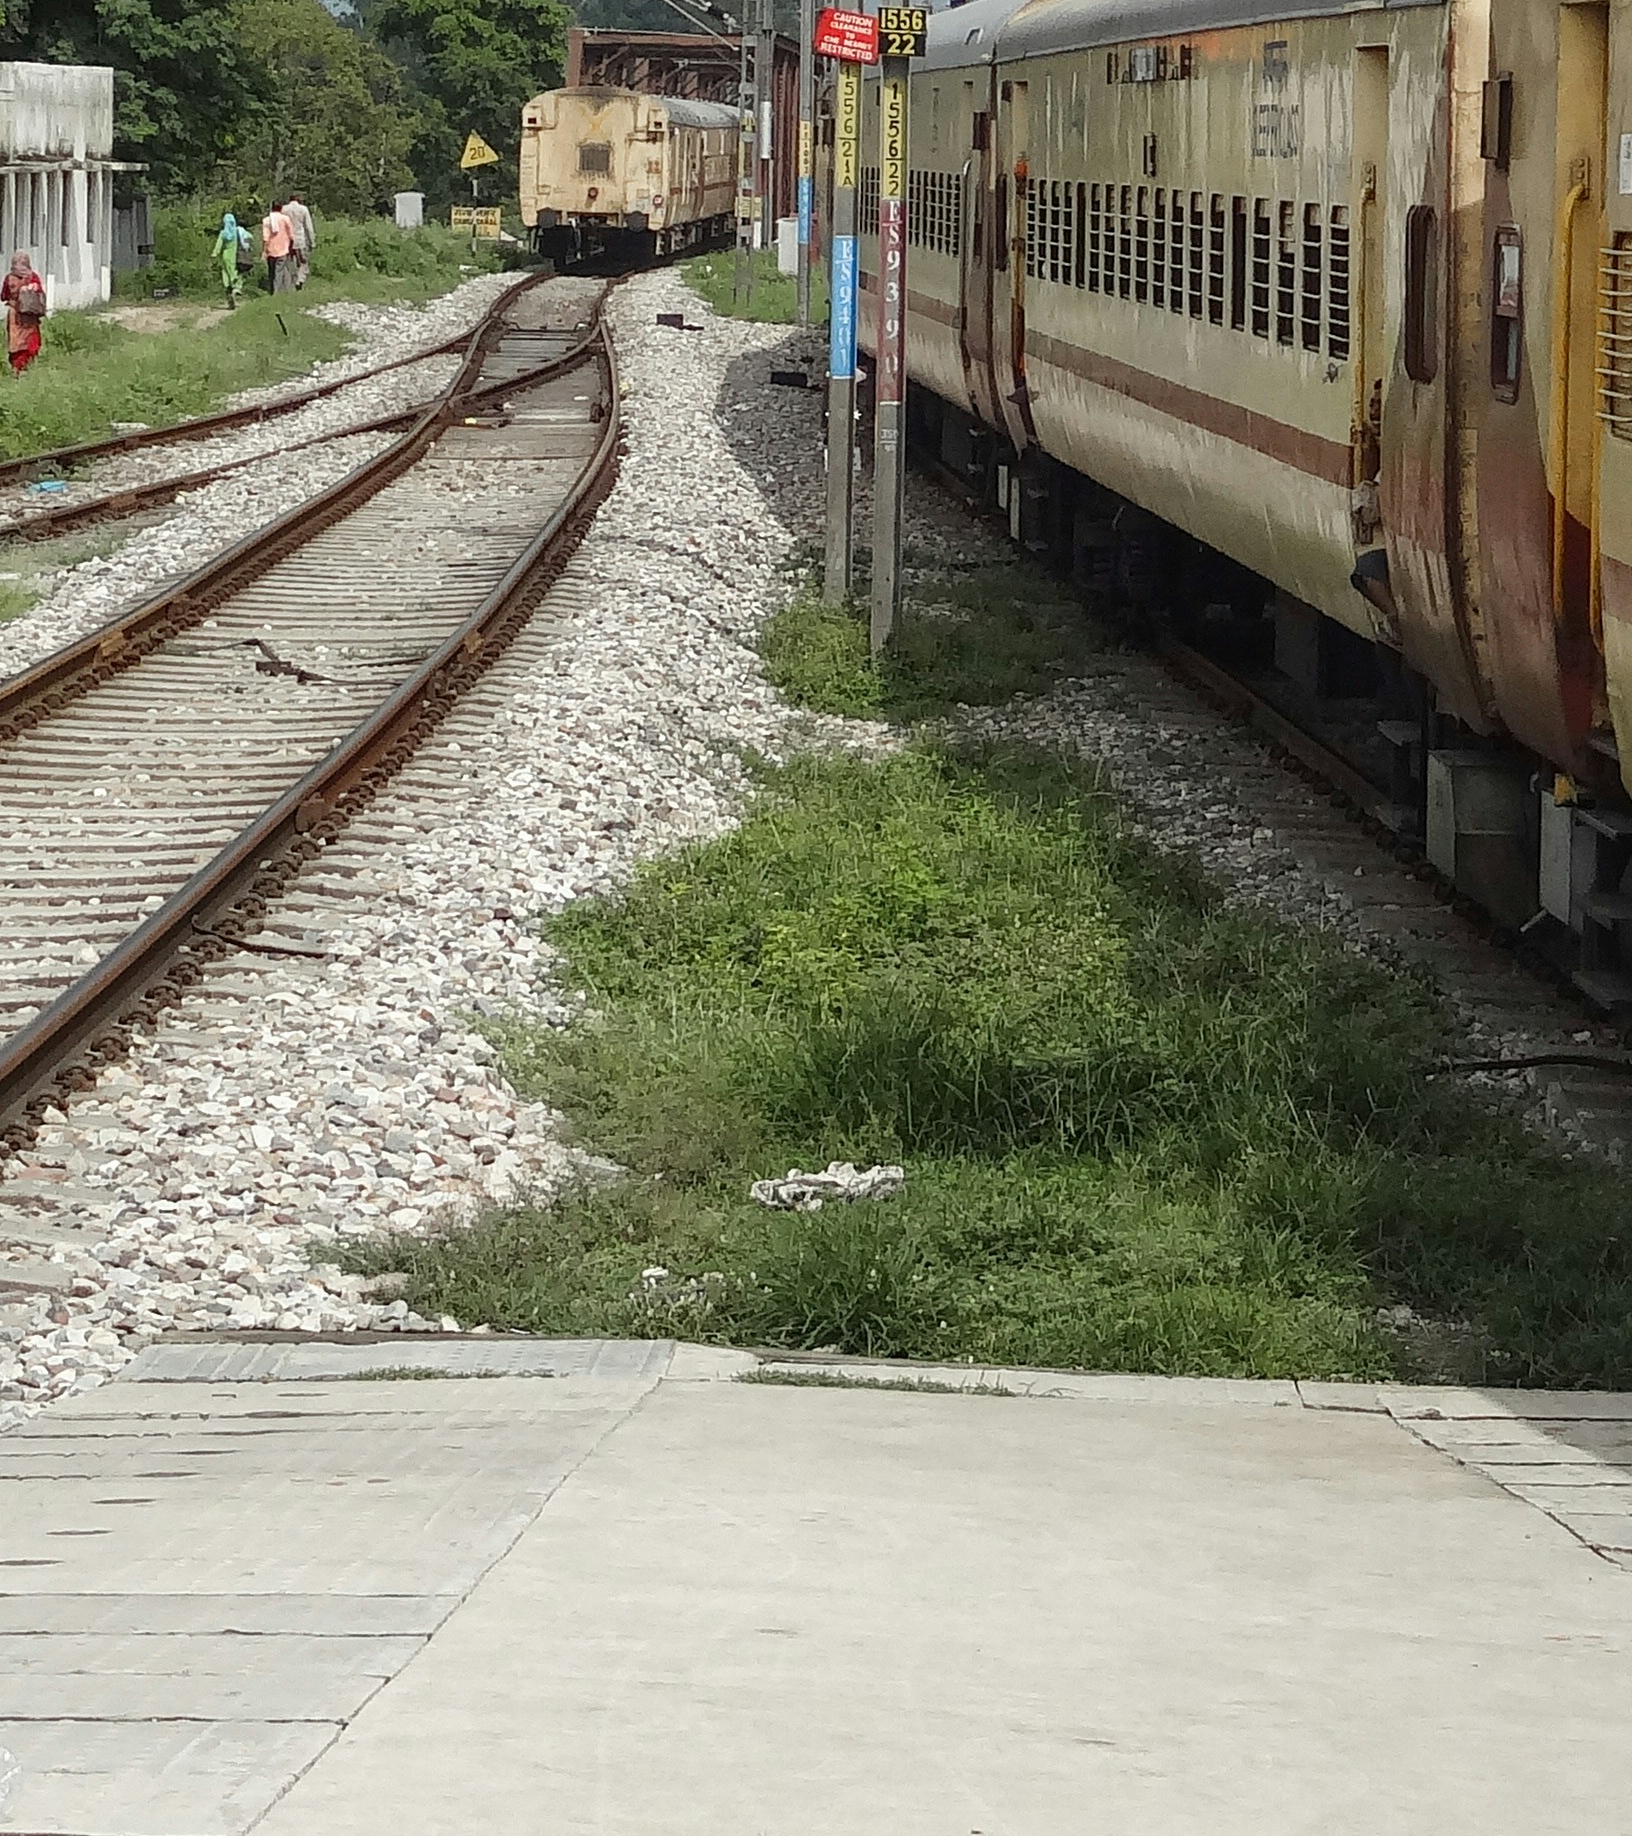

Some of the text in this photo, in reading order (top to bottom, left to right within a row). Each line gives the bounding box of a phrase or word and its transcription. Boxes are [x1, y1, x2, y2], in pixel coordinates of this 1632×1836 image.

[833, 12, 873, 27] CAUTION
[881, 9, 923, 30] 1556
[845, 32, 856, 40] TO
[888, 34, 915, 54] 22
[820, 42, 873, 61] RESTRICTED
[469, 146, 486, 161] 20
